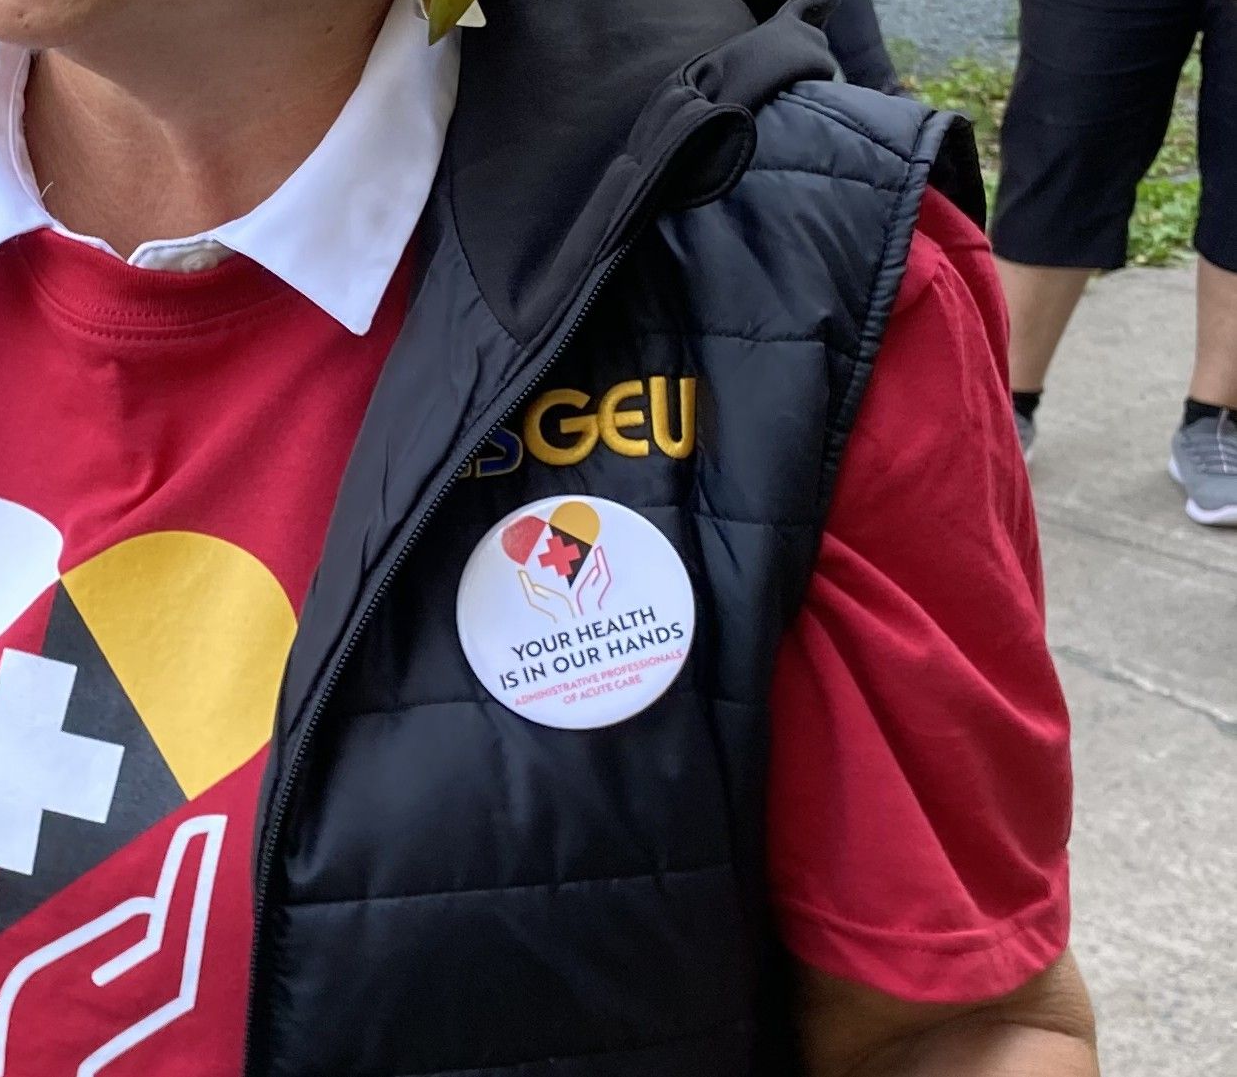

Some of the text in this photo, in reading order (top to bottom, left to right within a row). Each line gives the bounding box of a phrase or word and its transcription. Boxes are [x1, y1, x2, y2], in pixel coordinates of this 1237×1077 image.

[459, 376, 696, 478] SGEU
[499, 622, 684, 690] IS IN OUR HANDS
[511, 606, 657, 661] YOUR HEALTH
[515, 649, 684, 706] ADMINISTRATIVE PROFESSIONALS
[563, 674, 643, 704] OF ACUTE CARE
